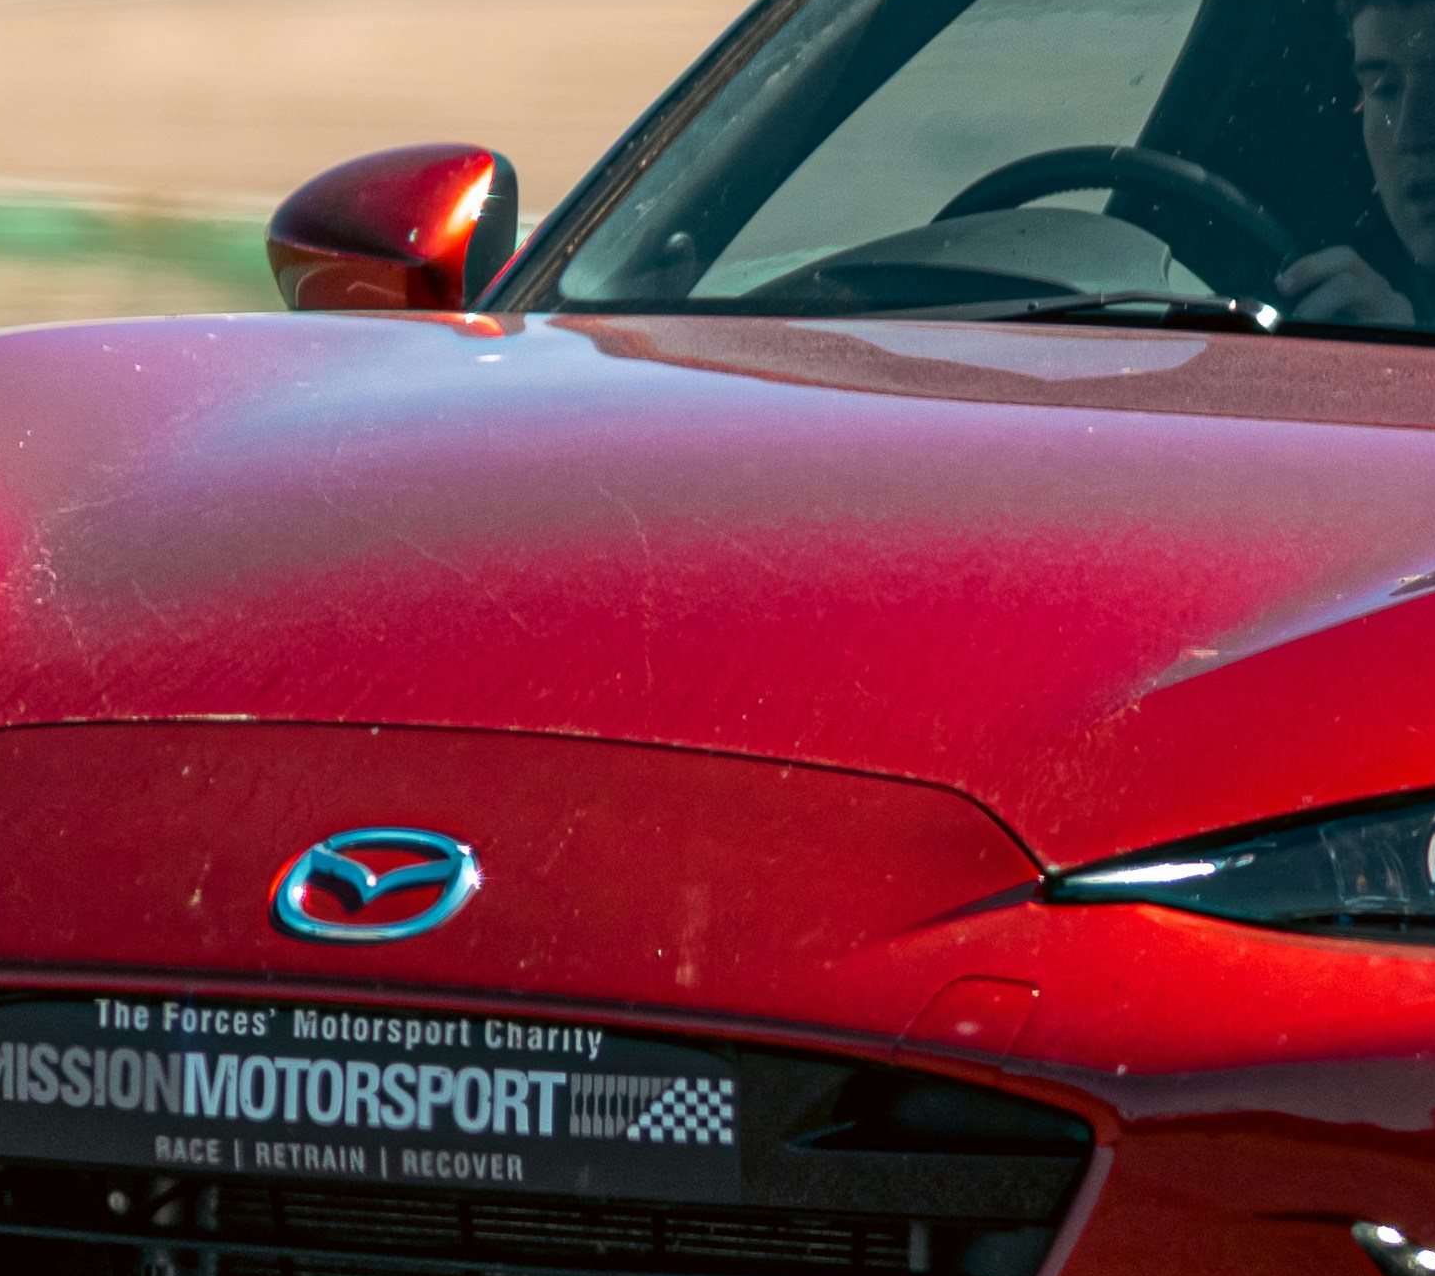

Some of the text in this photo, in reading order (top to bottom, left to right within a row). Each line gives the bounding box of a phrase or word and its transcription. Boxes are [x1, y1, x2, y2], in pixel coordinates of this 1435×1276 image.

[94, 998, 149, 1031] The
[293, 1009, 471, 1050] Motorsport
[484, 1019, 602, 1061] Charity
[154, 1135, 523, 1182] RACE RETRAIN RECOVER
